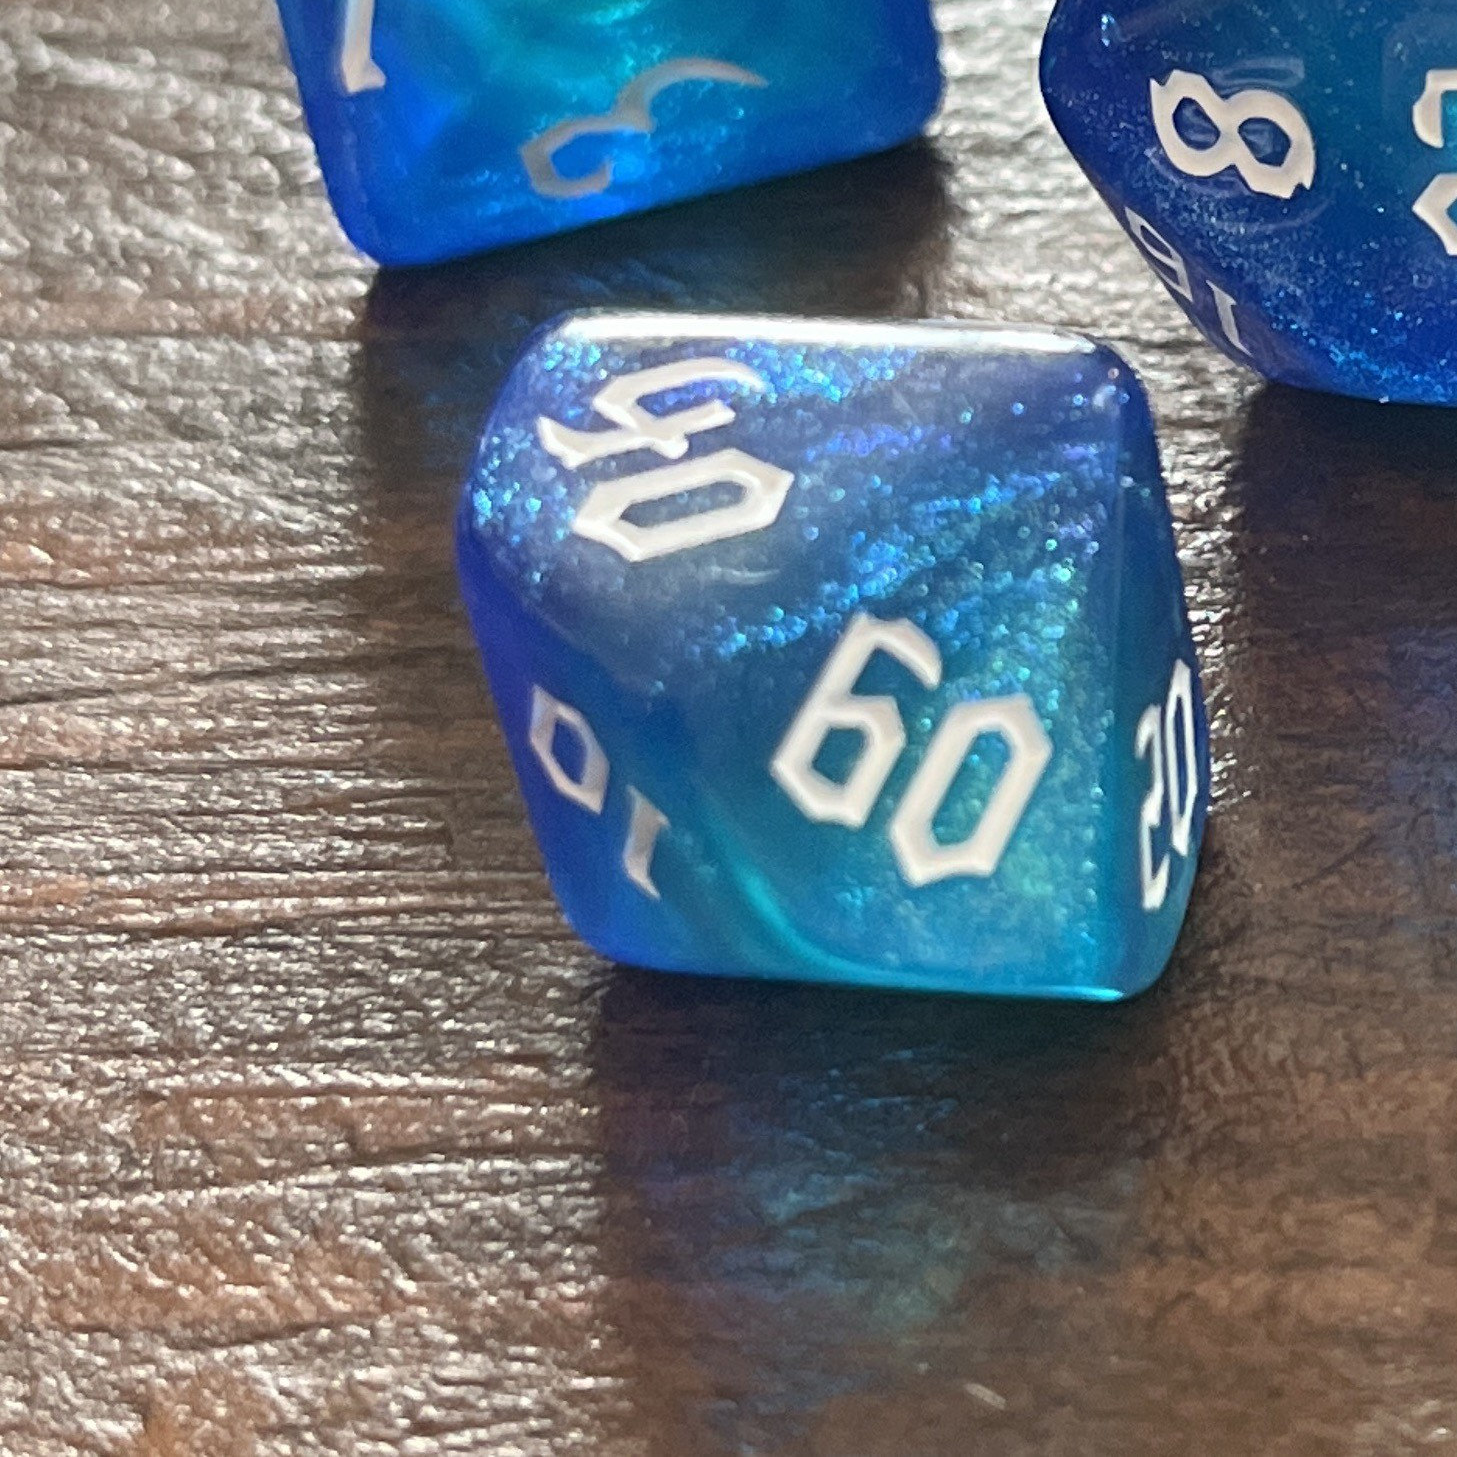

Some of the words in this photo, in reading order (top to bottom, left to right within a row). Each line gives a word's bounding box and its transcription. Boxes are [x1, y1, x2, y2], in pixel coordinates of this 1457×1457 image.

[1150, 68, 1316, 200] 8
[769, 611, 1054, 888] 60
[1136, 658, 1198, 912] 20
